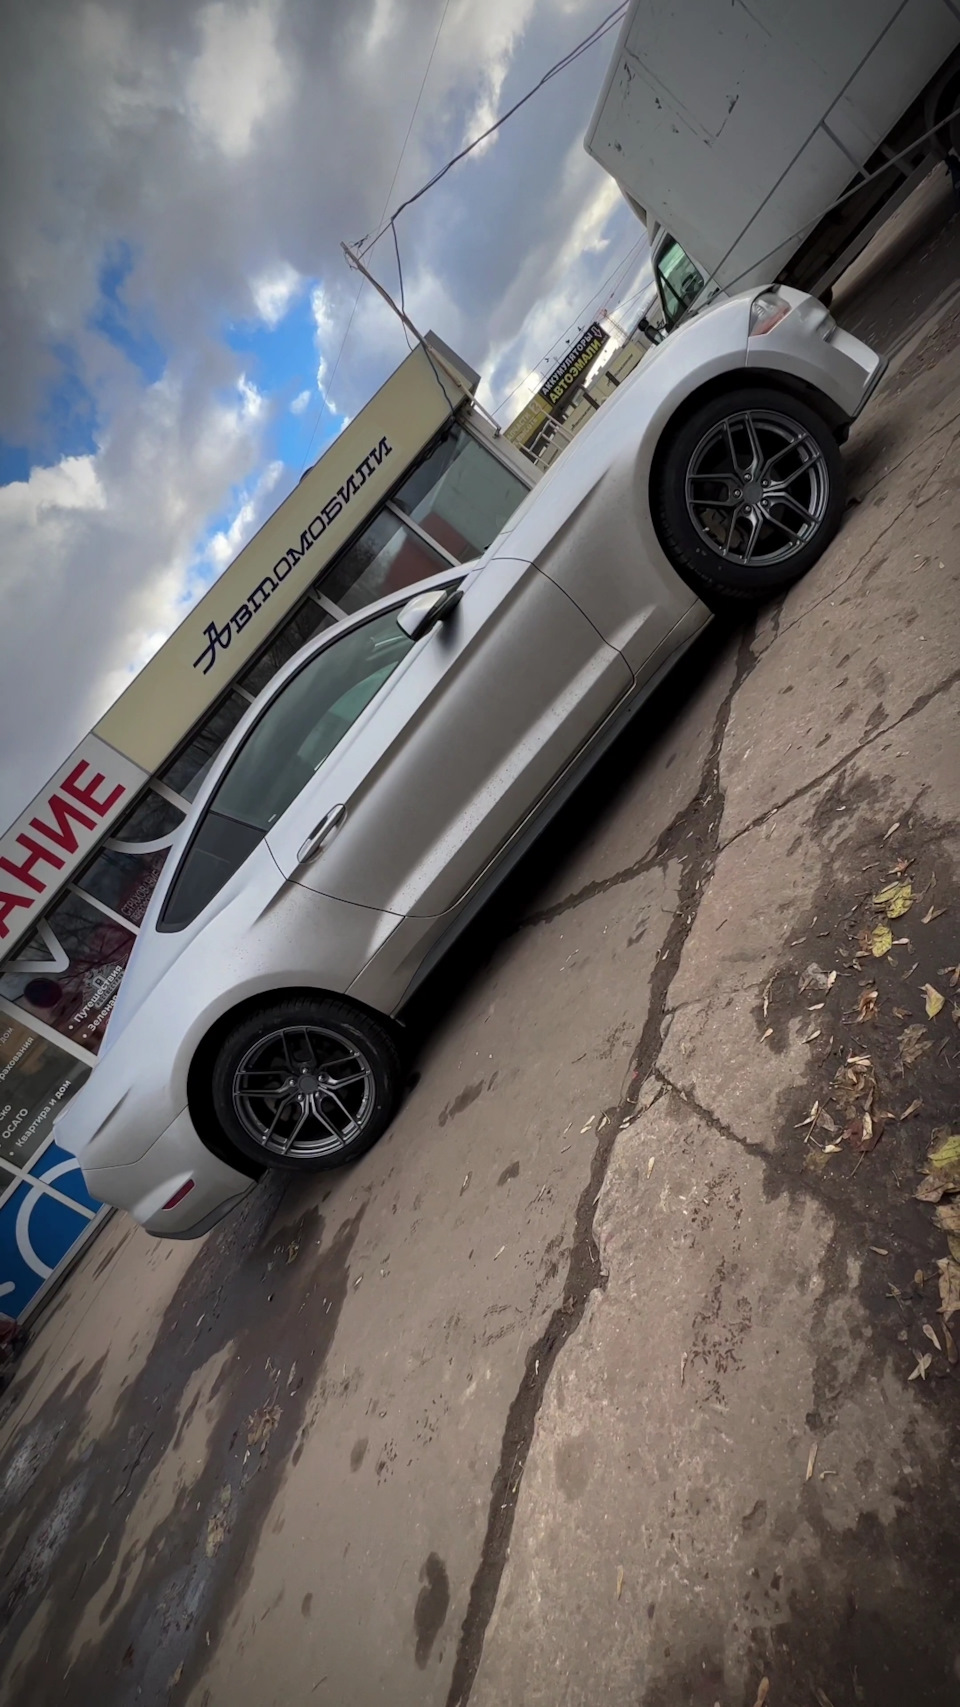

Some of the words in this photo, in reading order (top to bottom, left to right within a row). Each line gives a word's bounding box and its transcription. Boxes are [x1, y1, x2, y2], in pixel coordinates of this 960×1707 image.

[541, 333, 593, 396] АККУМУЛЯТОРЫ
[549, 338, 602, 404] АВТОЭМАЛИ
[74, 965, 123, 1022] Путешествия
[0, 1036, 34, 1081] рахования
[2, 1108, 29, 1139] ОСАГО
[15, 1105, 51, 1147] Квартира
[49, 1098, 57, 1107] и
[55, 1079, 72, 1100] дом
